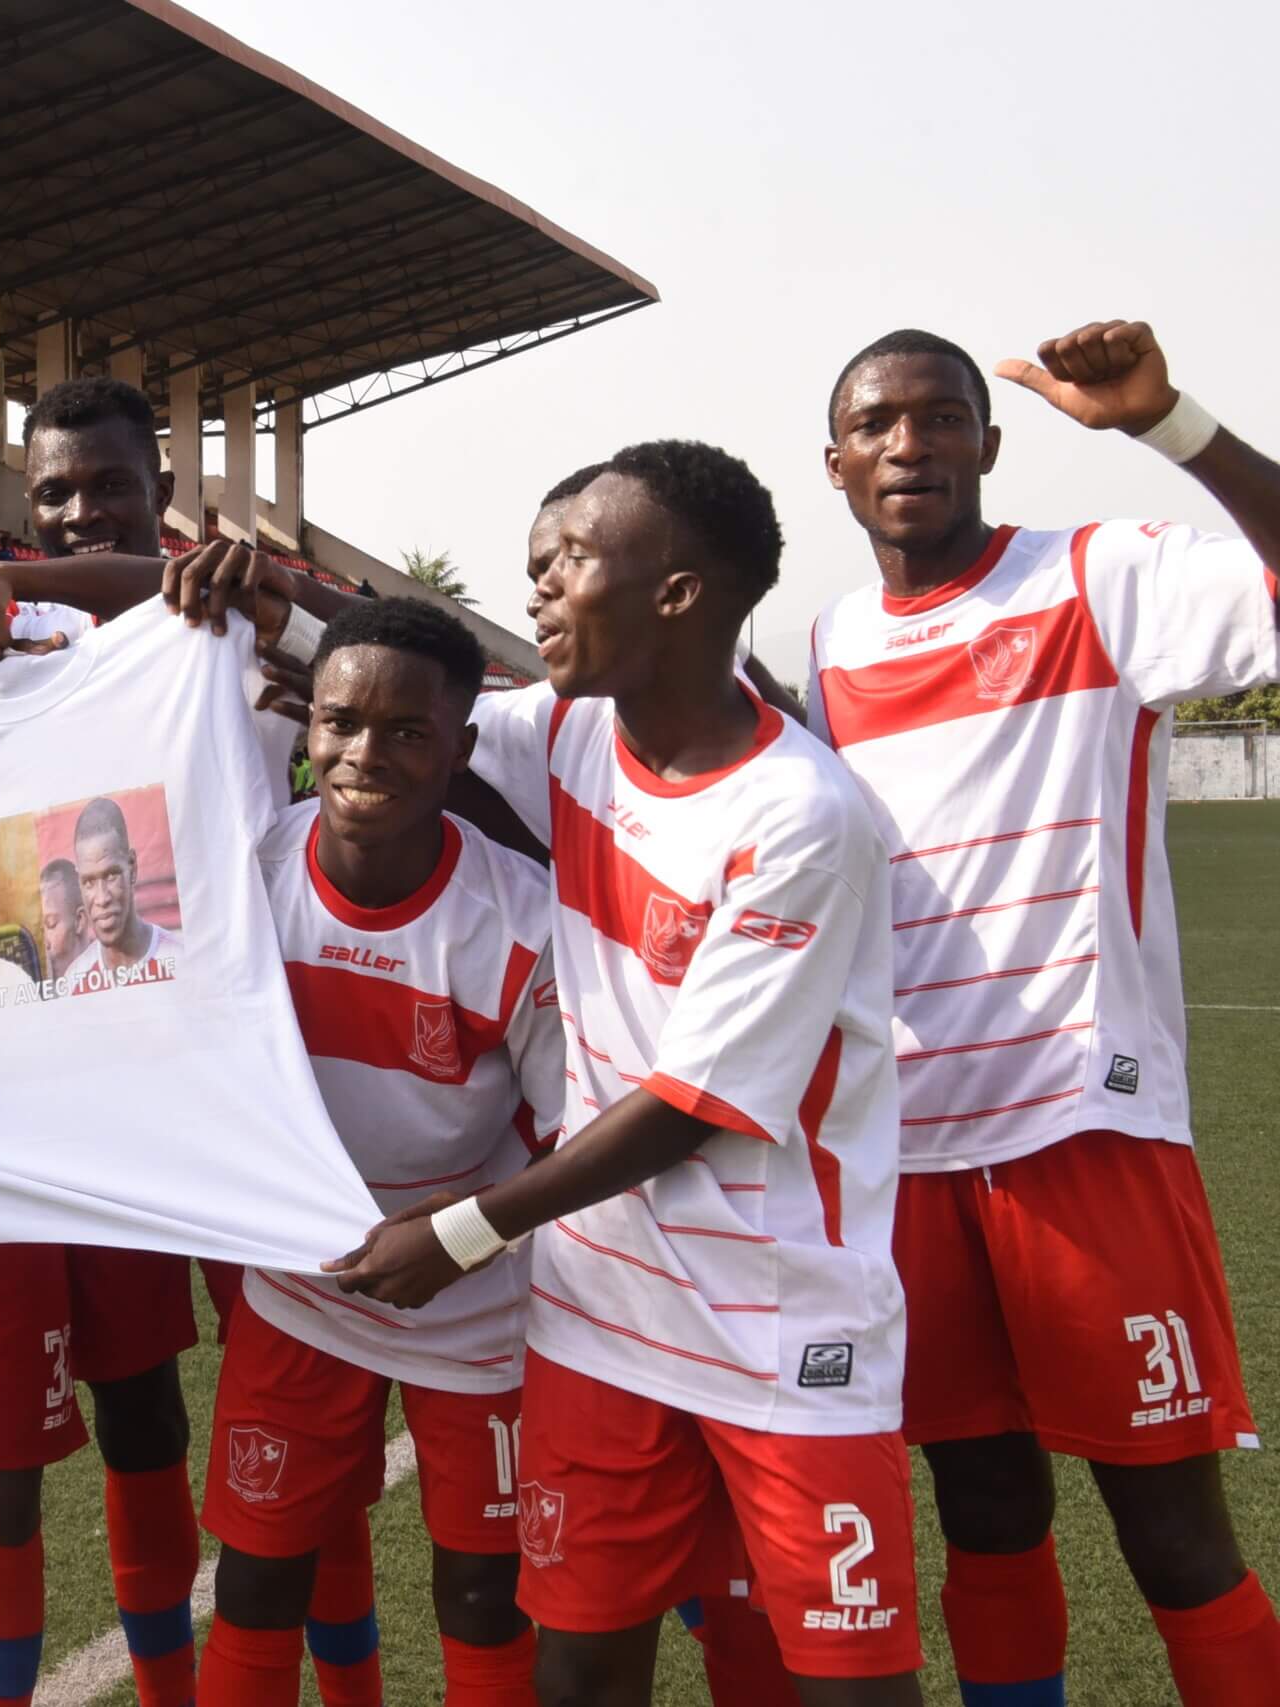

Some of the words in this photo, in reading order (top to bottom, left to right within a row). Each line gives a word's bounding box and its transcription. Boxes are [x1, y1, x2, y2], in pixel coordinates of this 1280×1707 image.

[885, 622, 954, 650] saller
[318, 944, 406, 972] saller
[14, 975, 70, 1006] AVEC
[1123, 1309, 1202, 1402] 31
[1130, 1397, 1212, 1427] saller
[823, 1503, 878, 1606] 2
[803, 1607, 899, 1630] saller
